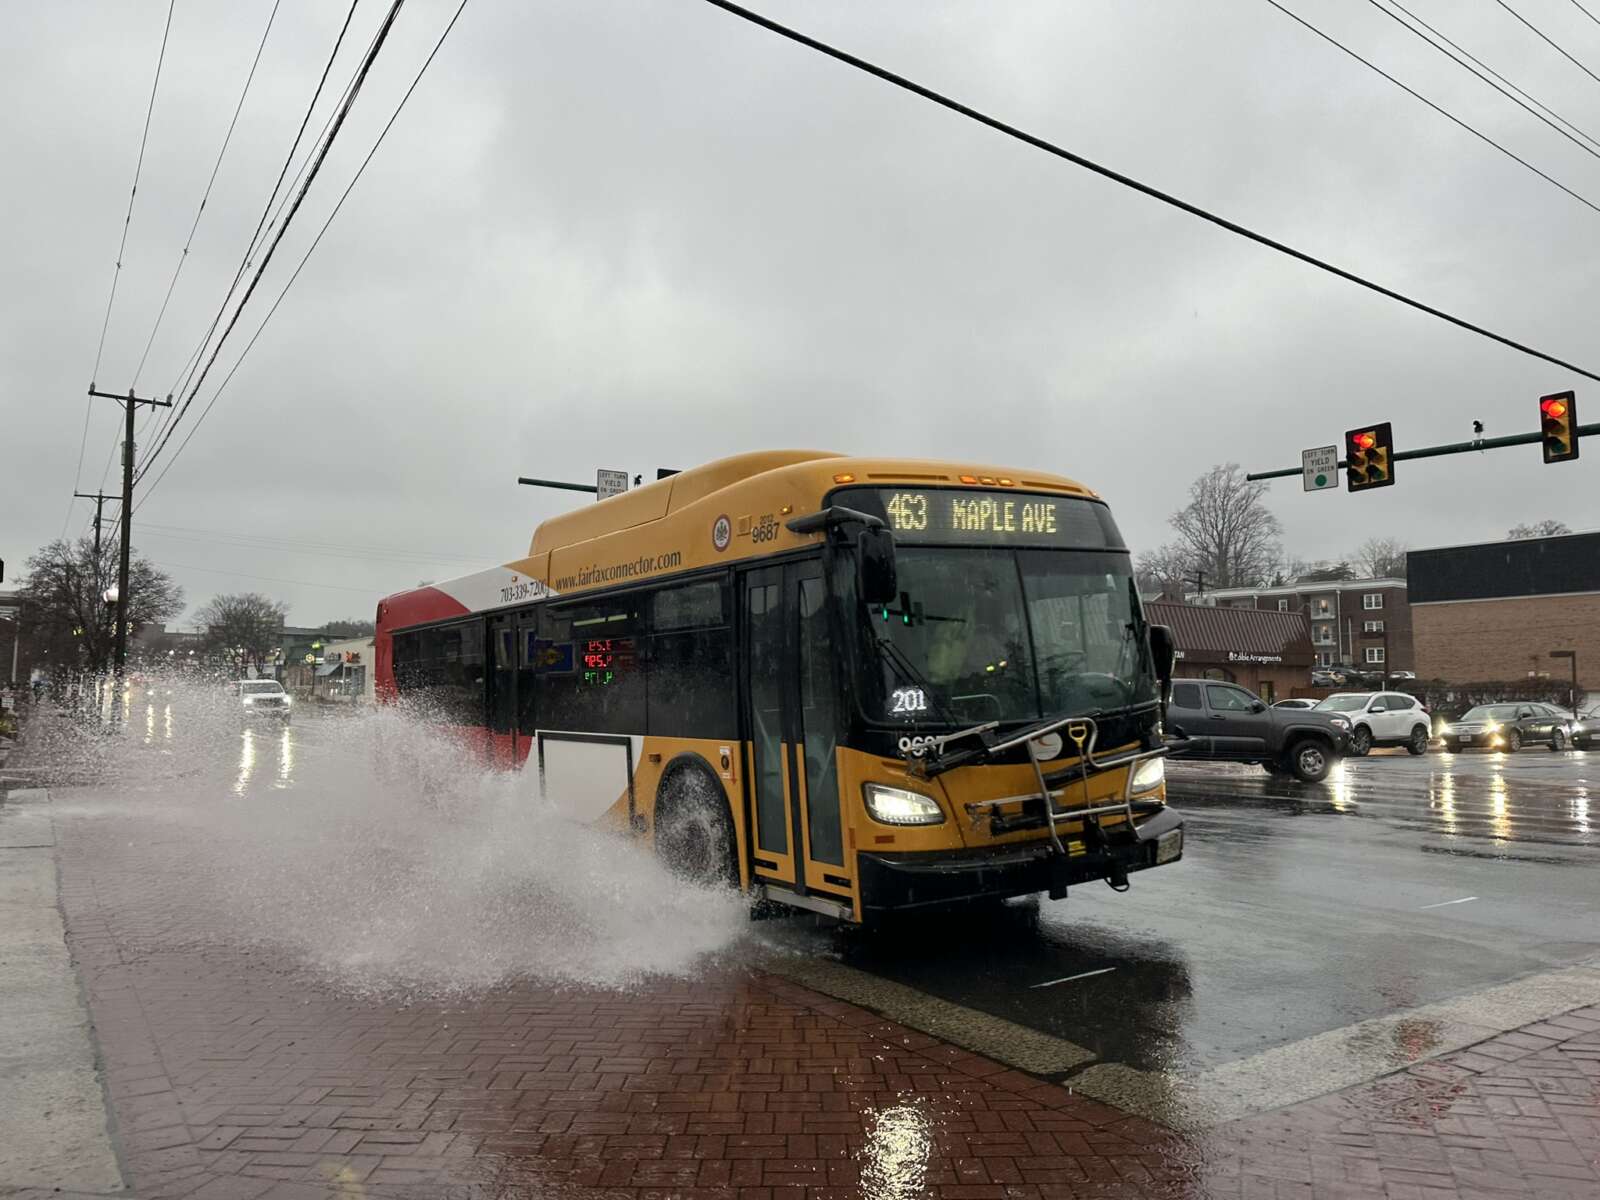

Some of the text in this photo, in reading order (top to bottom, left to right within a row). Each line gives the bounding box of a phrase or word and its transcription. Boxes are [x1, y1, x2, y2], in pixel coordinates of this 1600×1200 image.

[1311, 457, 1329, 466] YIELD
[887, 493, 1057, 533] 463 MAPLE AVE
[752, 522, 780, 543] 9687
[555, 551, 681, 590] www.fairfaxconnector.com
[892, 689, 927, 712] 201
